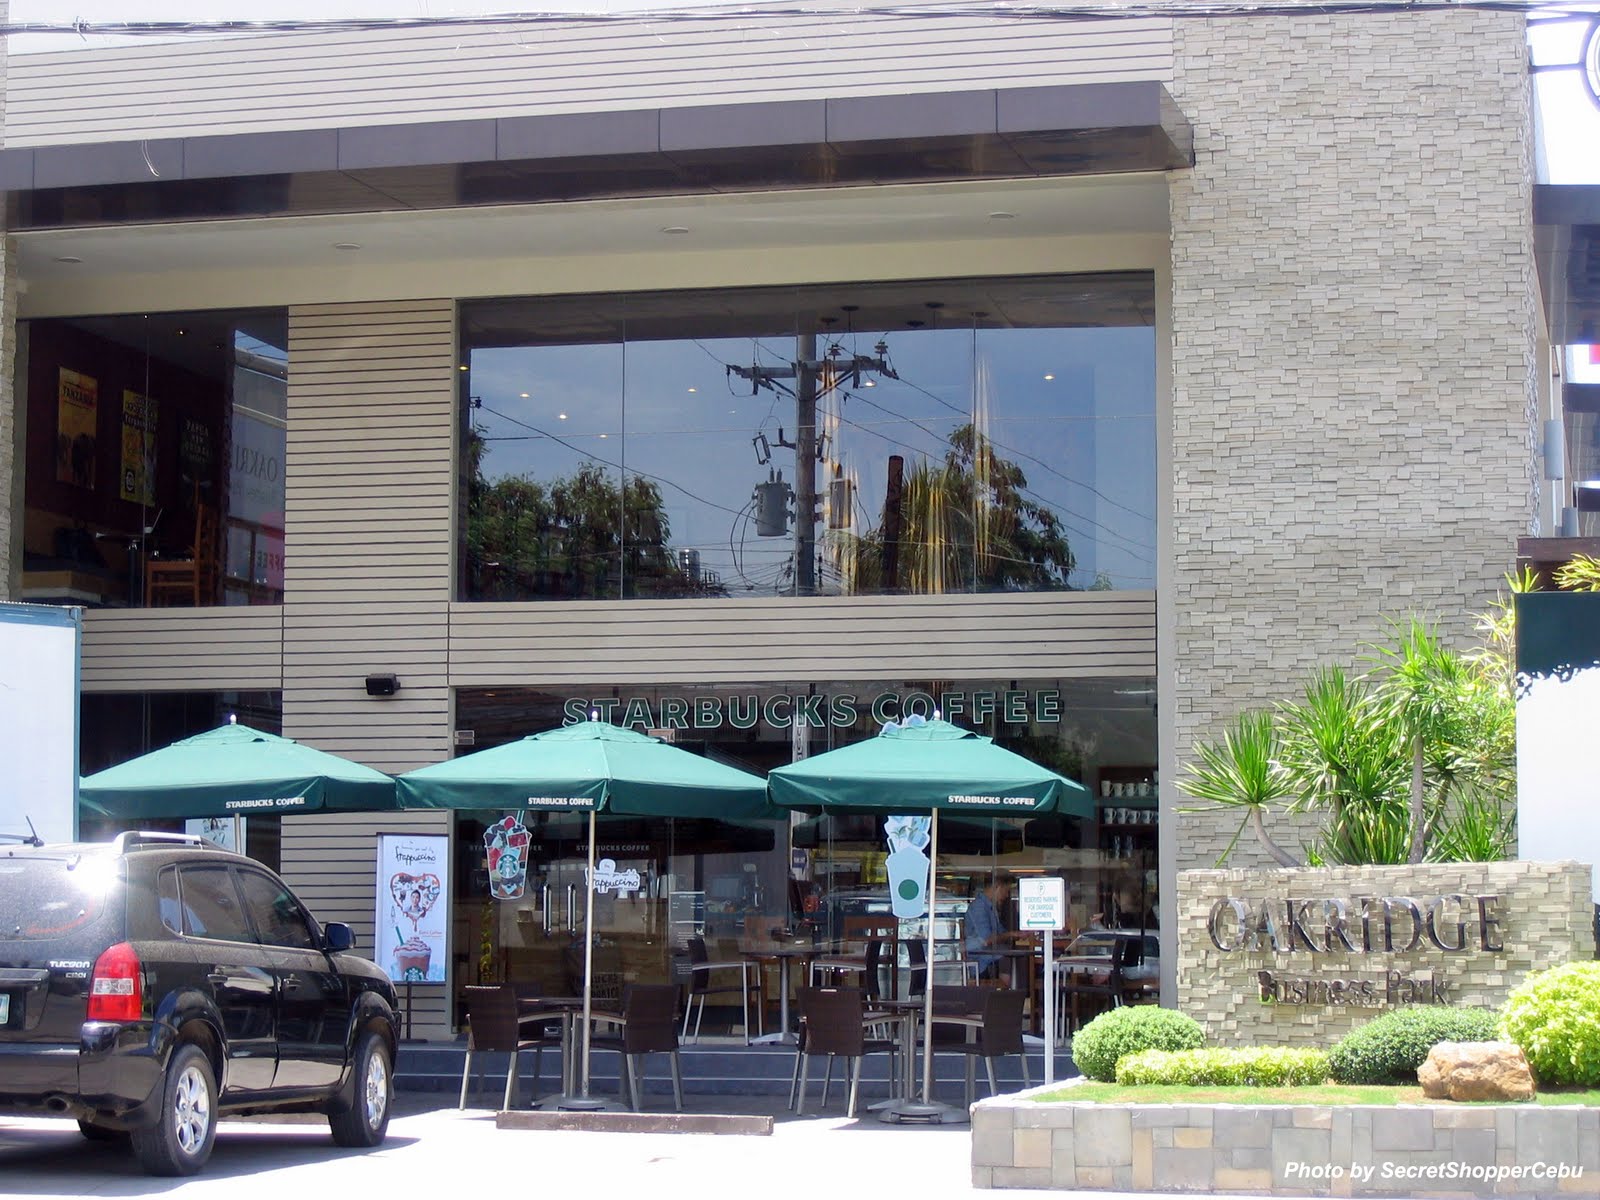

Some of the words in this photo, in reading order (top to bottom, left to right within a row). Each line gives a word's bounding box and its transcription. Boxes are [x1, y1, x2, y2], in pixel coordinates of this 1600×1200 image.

[562, 693, 857, 729] STARBUCKS
[871, 690, 1061, 726] COFFEE
[225, 799, 273, 809] STARBUCKS
[276, 797, 305, 806] COFFEE
[528, 797, 567, 805] STARBUCKS
[569, 797, 594, 806] COFFEE
[948, 795, 1000, 804] STARBUCKS
[1003, 797, 1036, 805] COFFEE
[1207, 895, 1504, 952] OAKRIDGE
[1257, 970, 1376, 1006] Business
[1386, 967, 1450, 1005] Park
